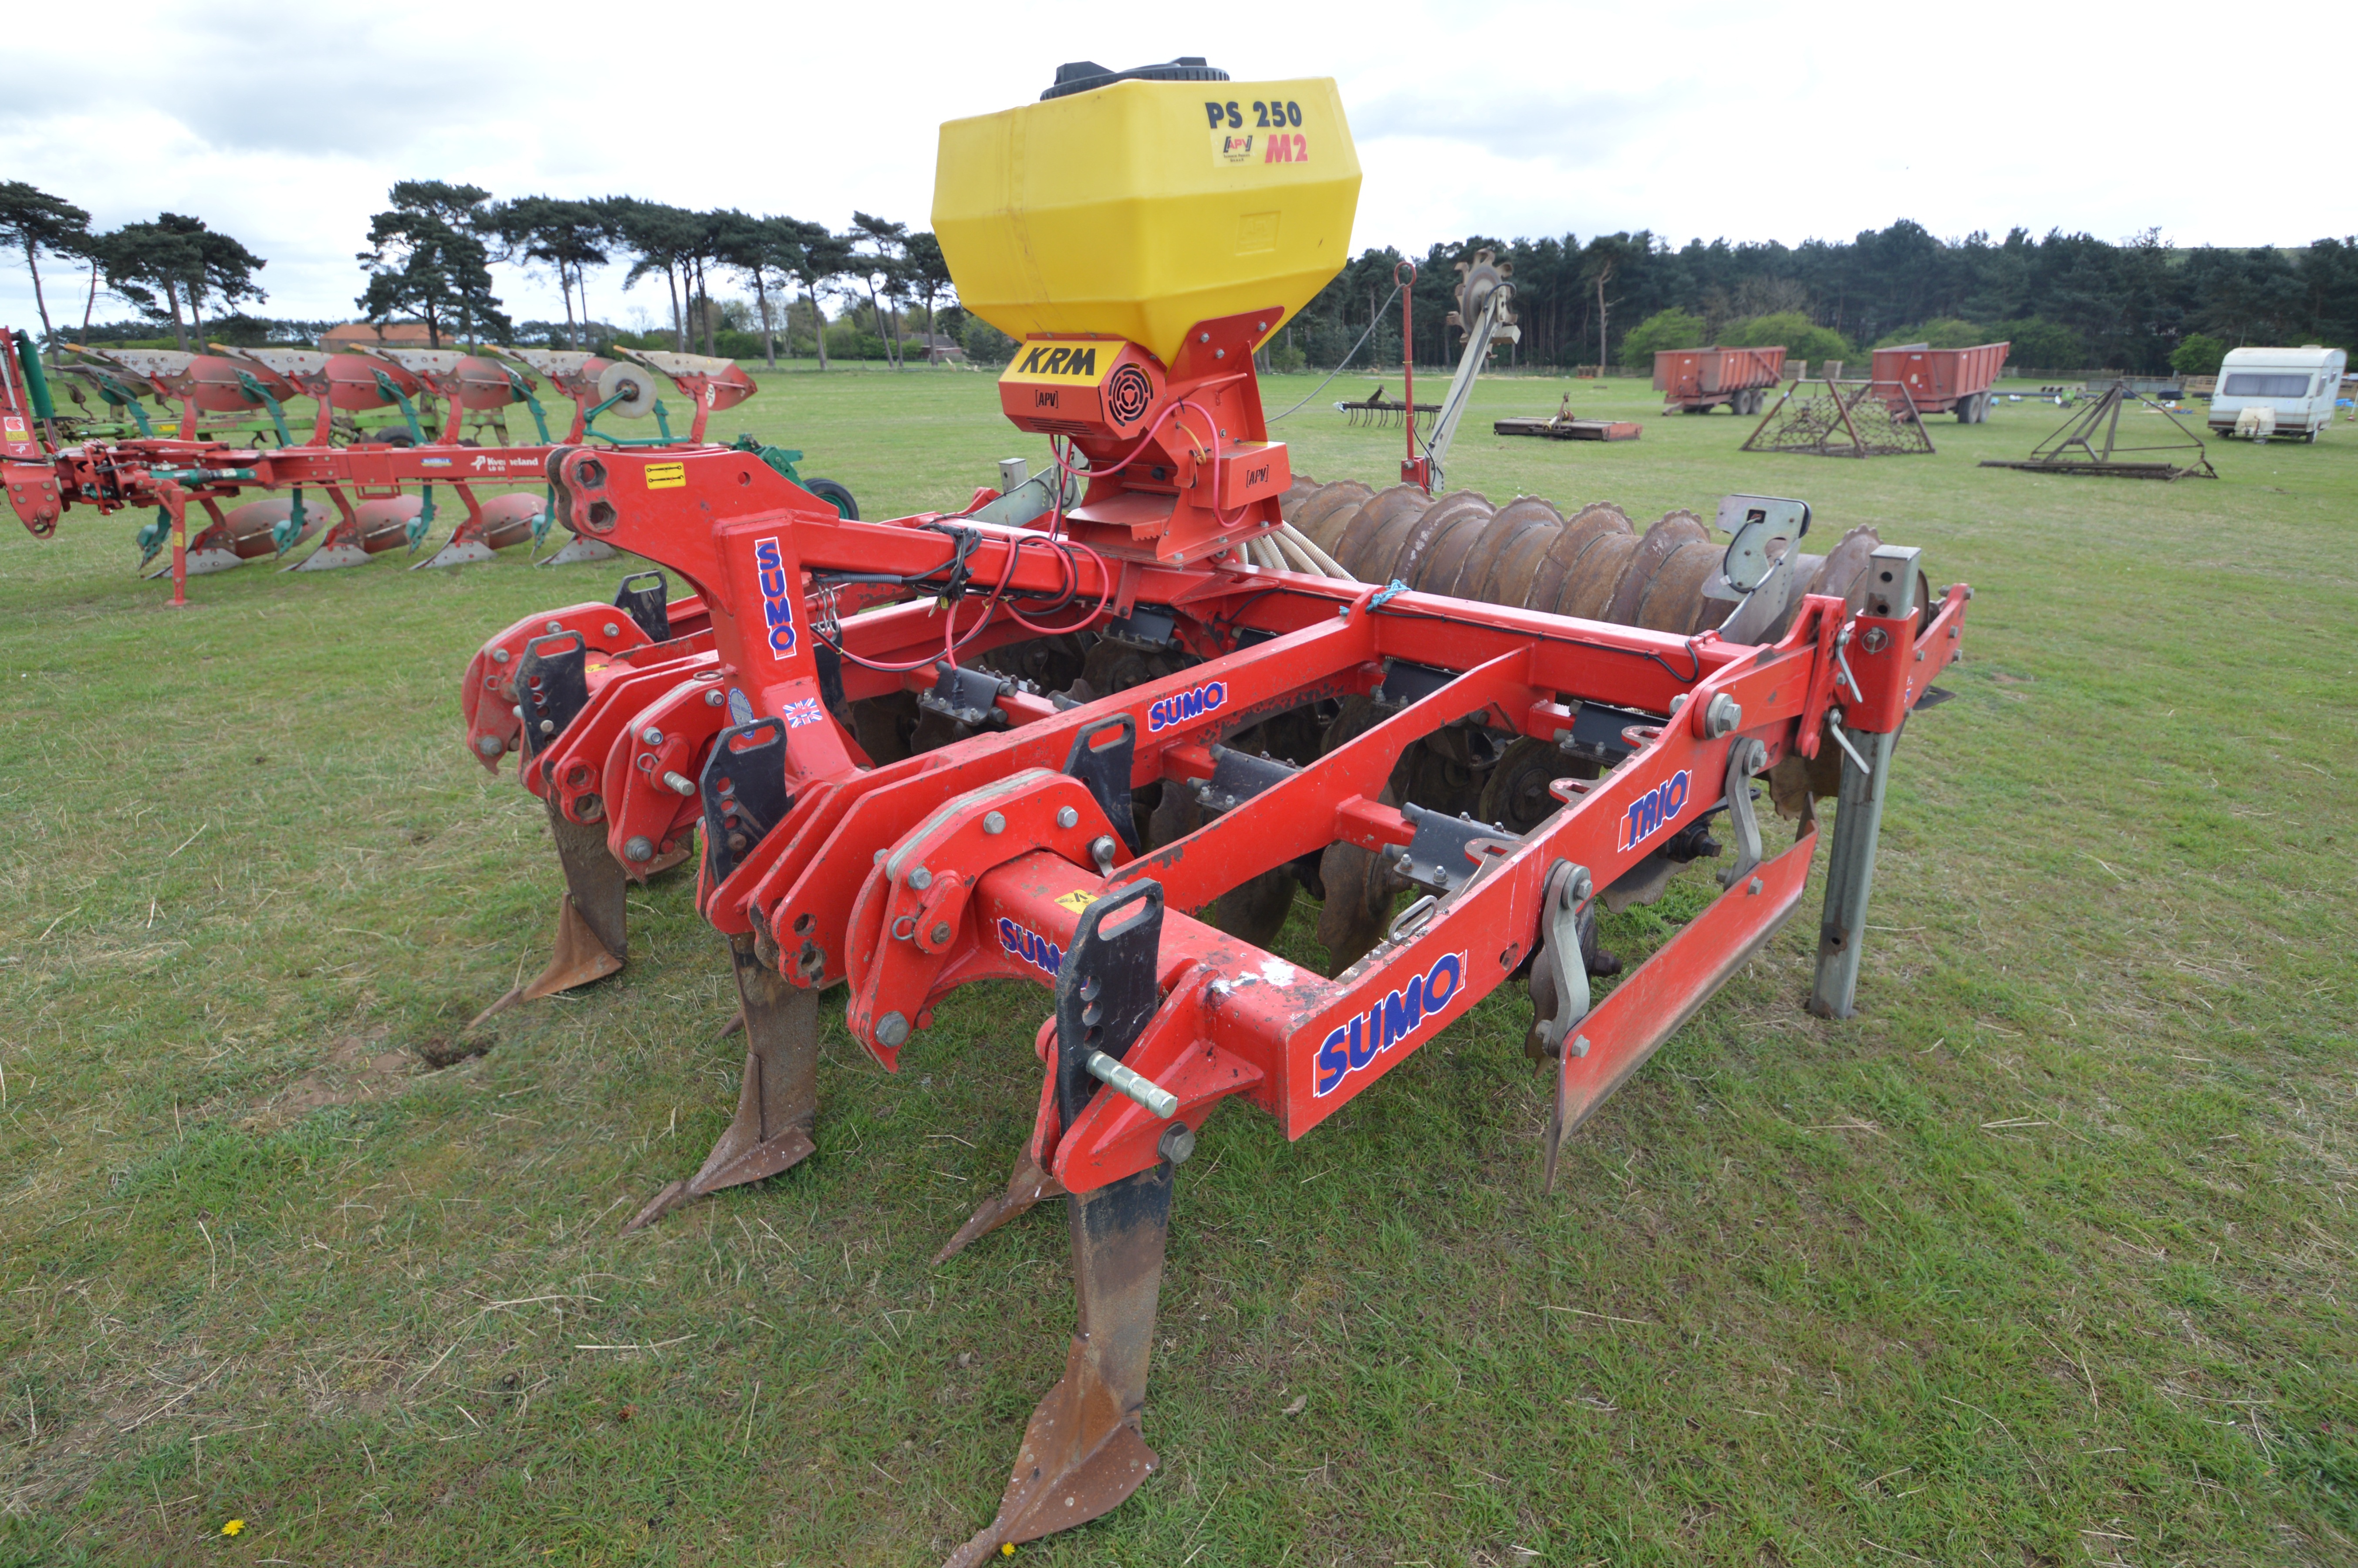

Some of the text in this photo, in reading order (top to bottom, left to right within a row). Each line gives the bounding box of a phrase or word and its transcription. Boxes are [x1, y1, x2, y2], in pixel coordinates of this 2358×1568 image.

[1205, 101, 1302, 129] PS 250
[1264, 133, 1308, 163] M2
[1017, 347, 1096, 376] KRM
[757, 542, 795, 651] SUMO
[1151, 683, 1223, 730] SUMO
[1628, 771, 1688, 849] TRIO
[1000, 918, 1066, 976] SUM
[1319, 954, 1460, 1095] SUMO
